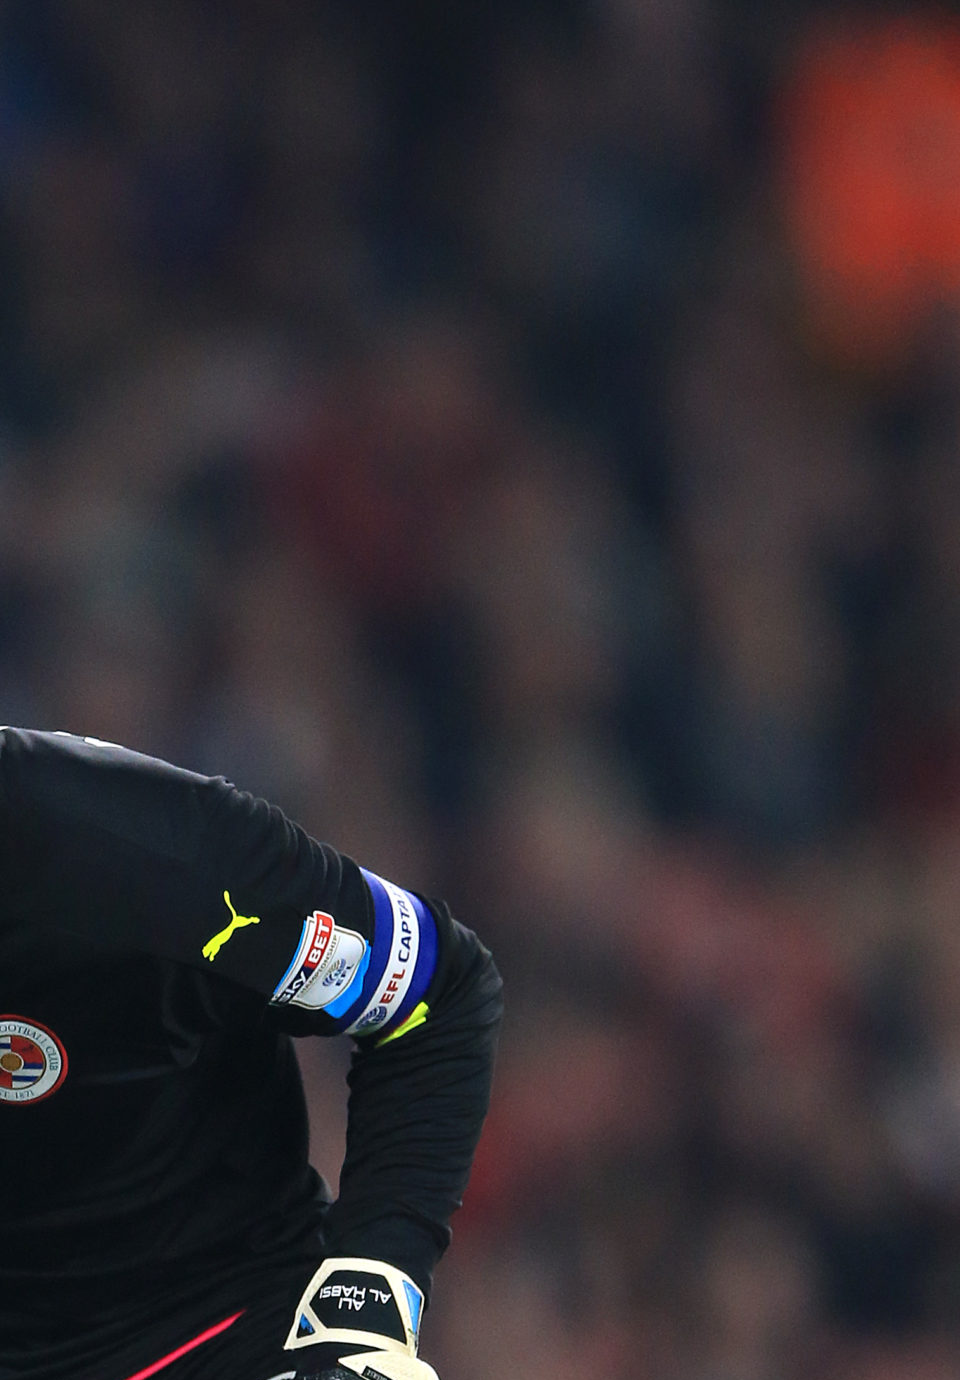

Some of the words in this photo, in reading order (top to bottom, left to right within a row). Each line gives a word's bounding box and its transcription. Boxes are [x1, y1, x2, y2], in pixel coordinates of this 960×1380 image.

[308, 919, 330, 964] BET
[378, 969, 405, 1004] EFL
[45, 1046, 59, 1071] CLUB
[320, 1285, 366, 1300] HABSI
[369, 1288, 392, 1304] AL
[338, 1297, 366, 1311] ALI
